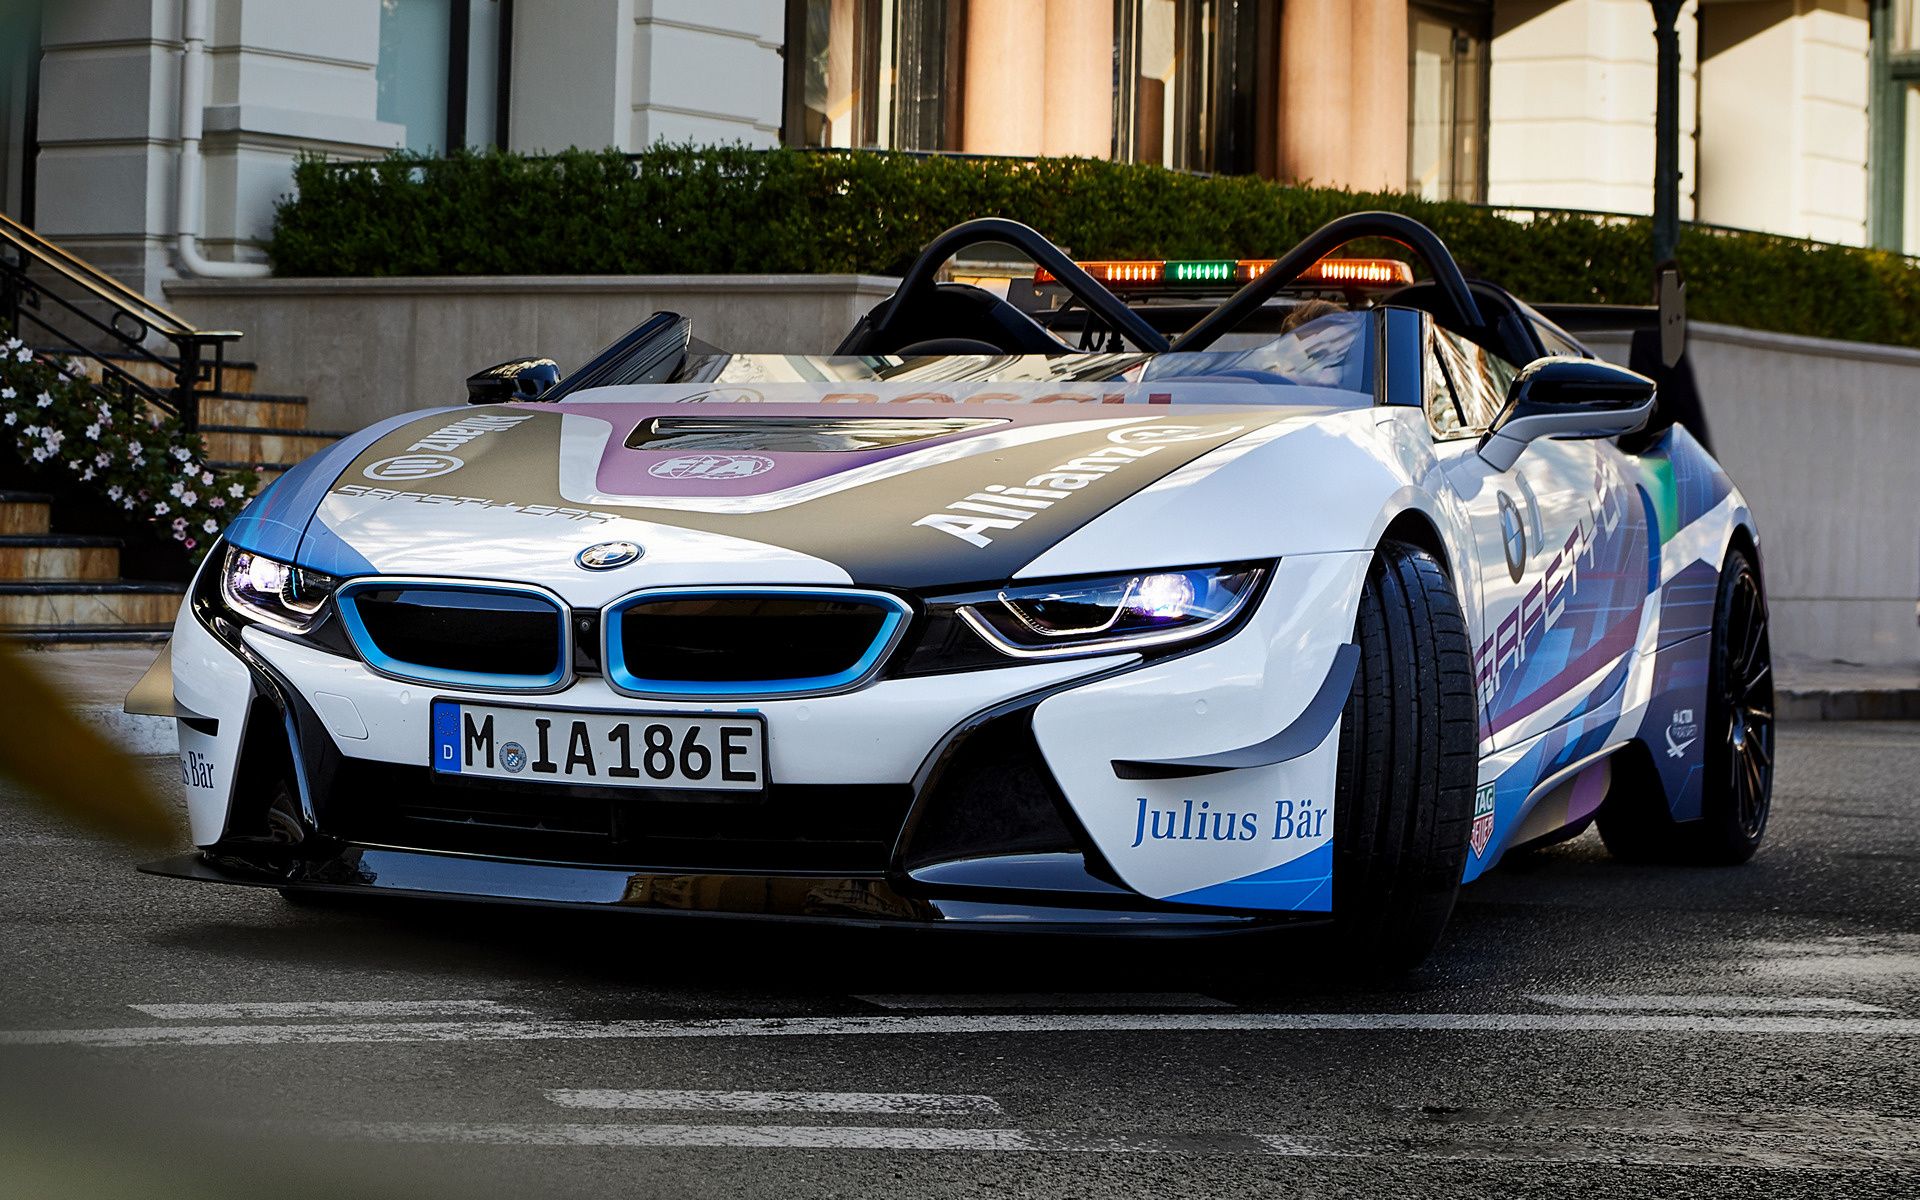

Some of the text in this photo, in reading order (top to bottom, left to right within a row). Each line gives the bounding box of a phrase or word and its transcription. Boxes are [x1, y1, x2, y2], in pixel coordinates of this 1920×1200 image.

[405, 414, 535, 452] Allianz
[651, 457, 758, 476] FIA
[910, 445, 1167, 550] Allianz
[442, 744, 454, 760] D
[463, 711, 495, 769] M
[187, 750, 215, 789] Bär
[1130, 797, 1328, 849] Julius Bär
